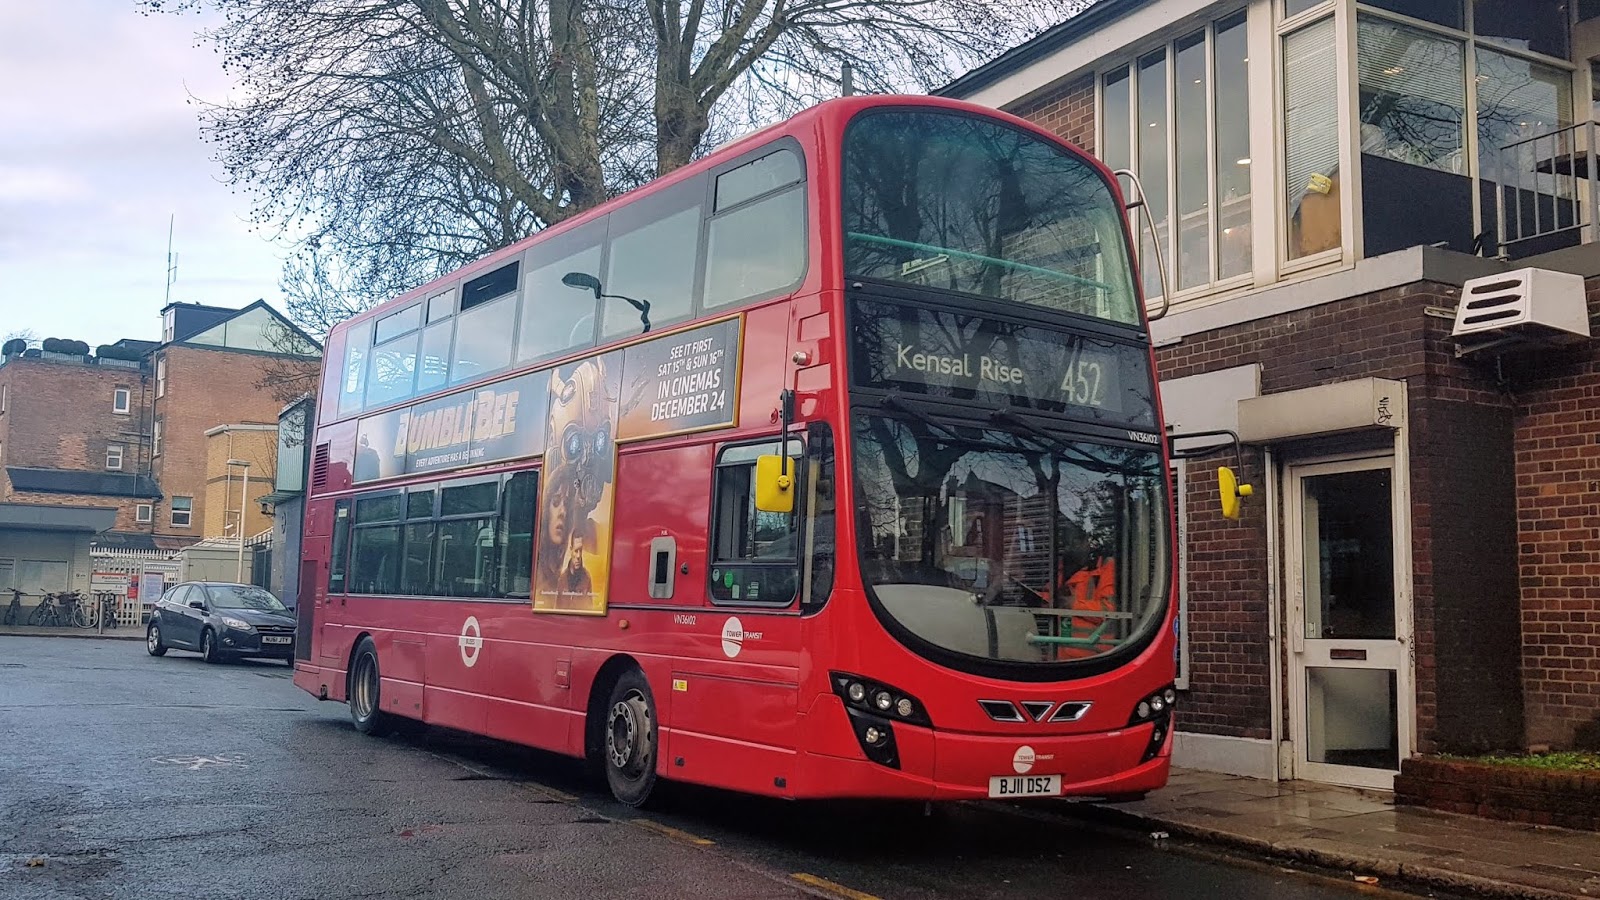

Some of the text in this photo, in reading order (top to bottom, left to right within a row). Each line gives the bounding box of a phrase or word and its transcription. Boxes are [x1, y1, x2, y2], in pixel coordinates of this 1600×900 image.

[670, 337, 713, 360] SEE IT FIRST
[657, 348, 725, 377] SAT 15TH & SUN 16TH
[896, 343, 1023, 384] Kensal Rise
[657, 368, 721, 400] IN CINEMAS
[1060, 360, 1101, 406] 452
[651, 389, 726, 421] DECEMBER 24
[1127, 430, 1159, 445] VN36102
[673, 614, 696, 625] VN36102
[726, 630, 763, 640] TOWER TRANSIT
[1027, 777, 1051, 793] DSZ
